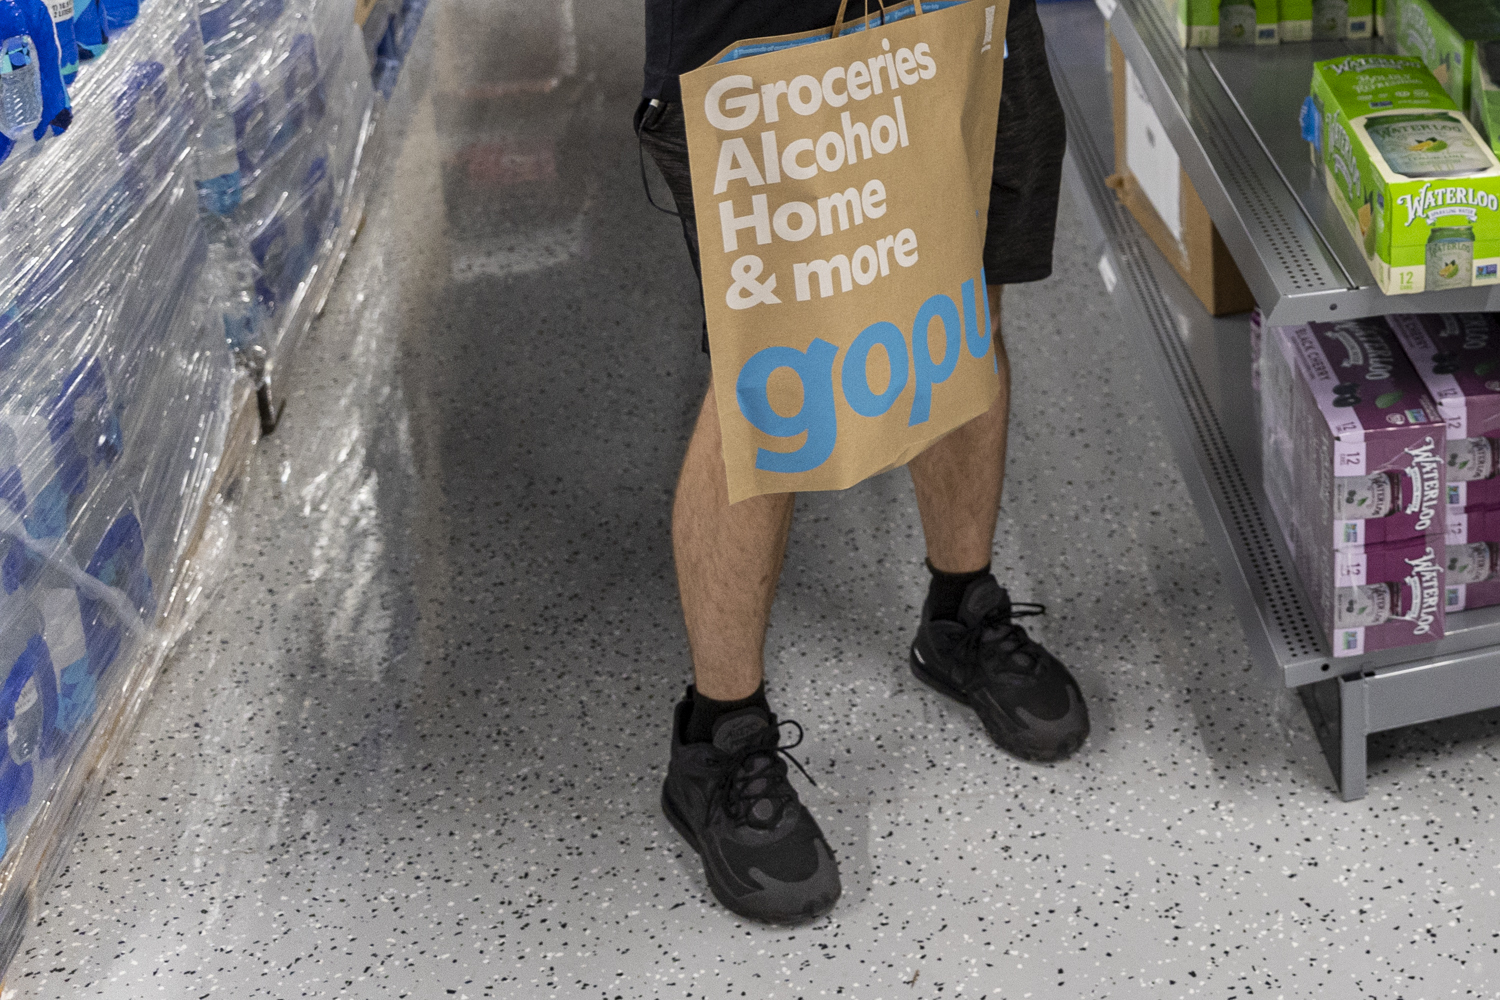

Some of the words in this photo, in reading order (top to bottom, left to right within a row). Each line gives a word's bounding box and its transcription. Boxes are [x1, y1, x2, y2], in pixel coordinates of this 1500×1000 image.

[704, 38, 937, 131] Groceries
[1324, 57, 1422, 76] WATERLOO
[712, 96, 909, 195] Alcohol
[1375, 122, 1461, 139] WATERLOO
[718, 178, 887, 253] Home
[1397, 183, 1499, 227] WATERLOO
[725, 254, 782, 310] &
[793, 227, 919, 302] more
[1400, 271, 1414, 285] 12
[1295, 327, 1315, 350] BLACK
[735, 266, 998, 474] gopu
[1306, 351, 1331, 381] CHERRY
[1447, 414, 1461, 430] 12
[1347, 452, 1360, 465] 12
[1404, 436, 1444, 531] WATERLOO
[1347, 562, 1361, 576] 12
[1404, 547, 1444, 635] WATERLOO
